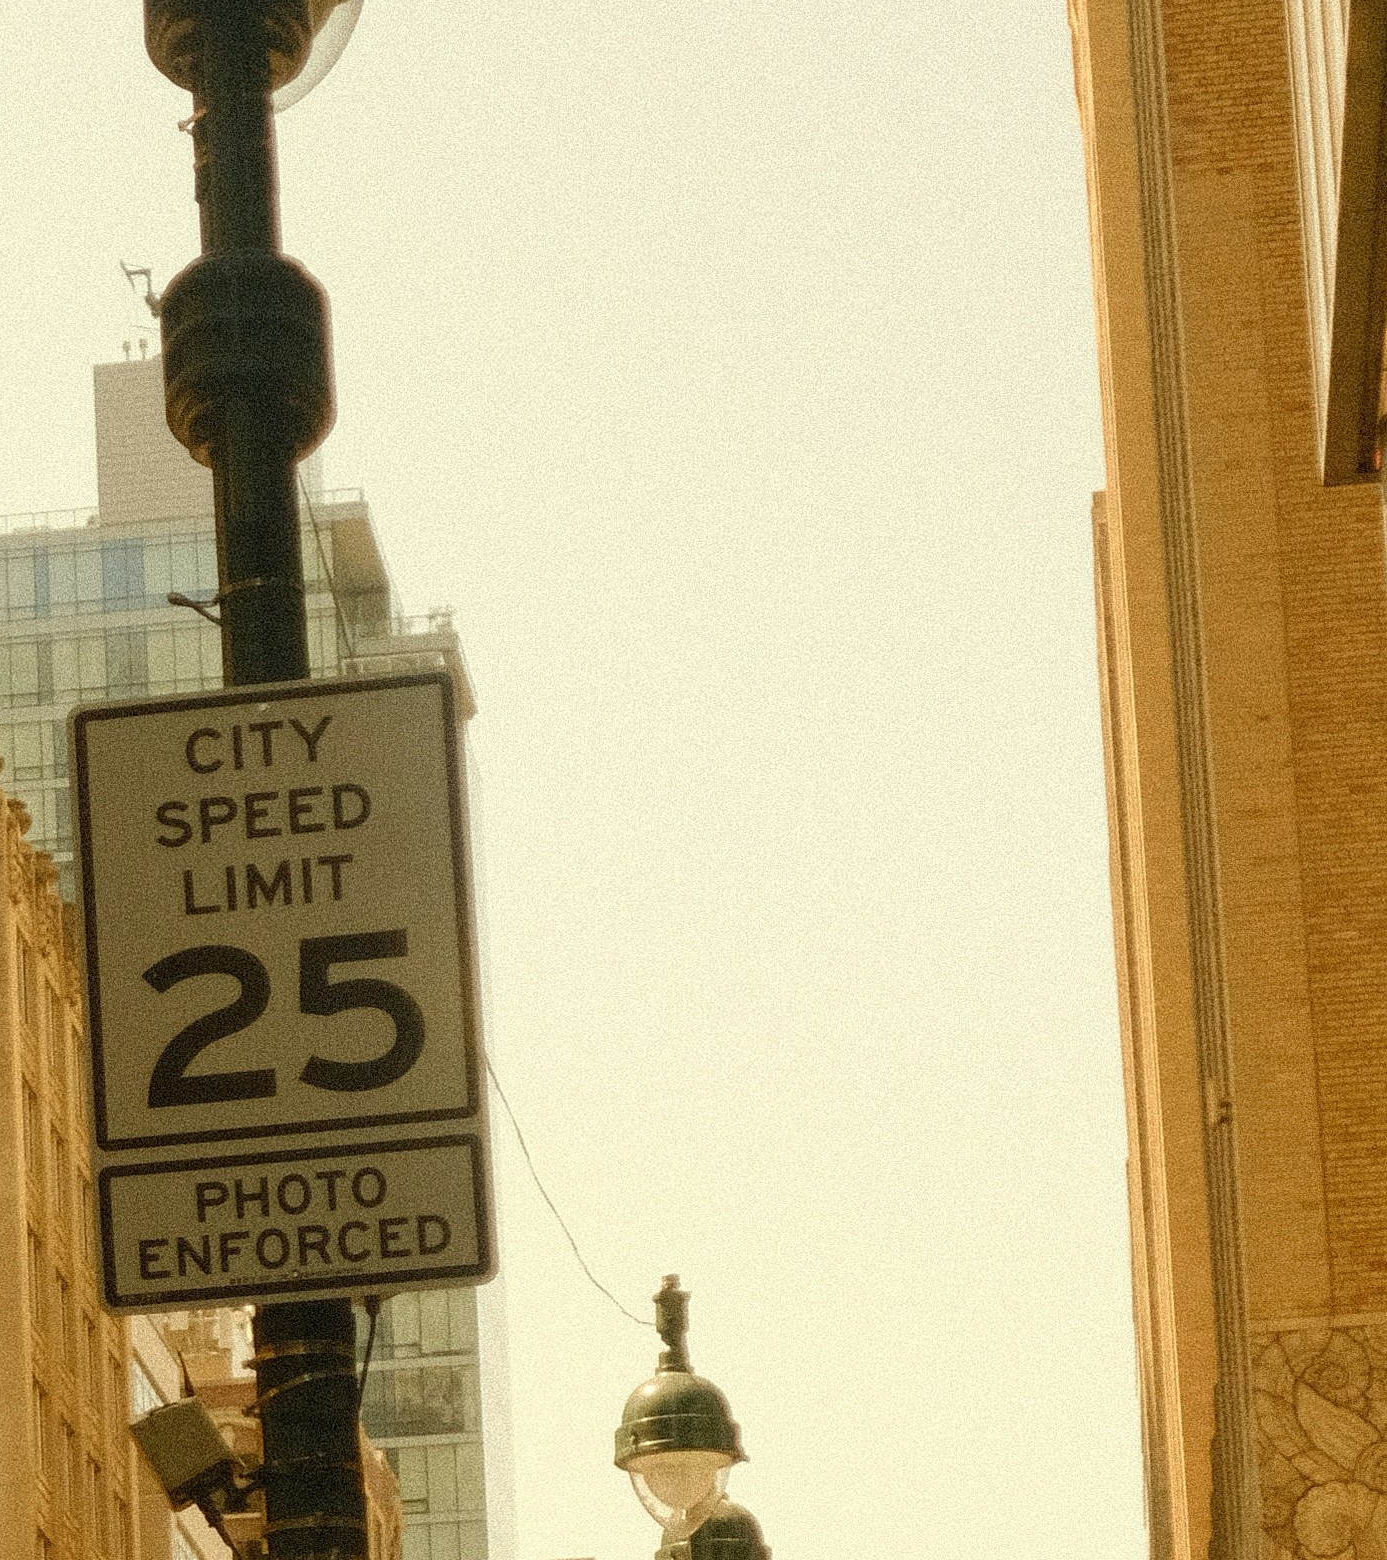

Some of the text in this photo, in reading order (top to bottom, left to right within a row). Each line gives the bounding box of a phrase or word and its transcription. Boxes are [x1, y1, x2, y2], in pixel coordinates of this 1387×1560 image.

[185, 716, 333, 774] CITY
[155, 783, 372, 848] SPEED
[183, 854, 354, 915] LIMIT
[141, 928, 426, 1108] 25
[196, 1167, 387, 1222] PHOTO
[138, 1215, 452, 1280] ENFORCED
